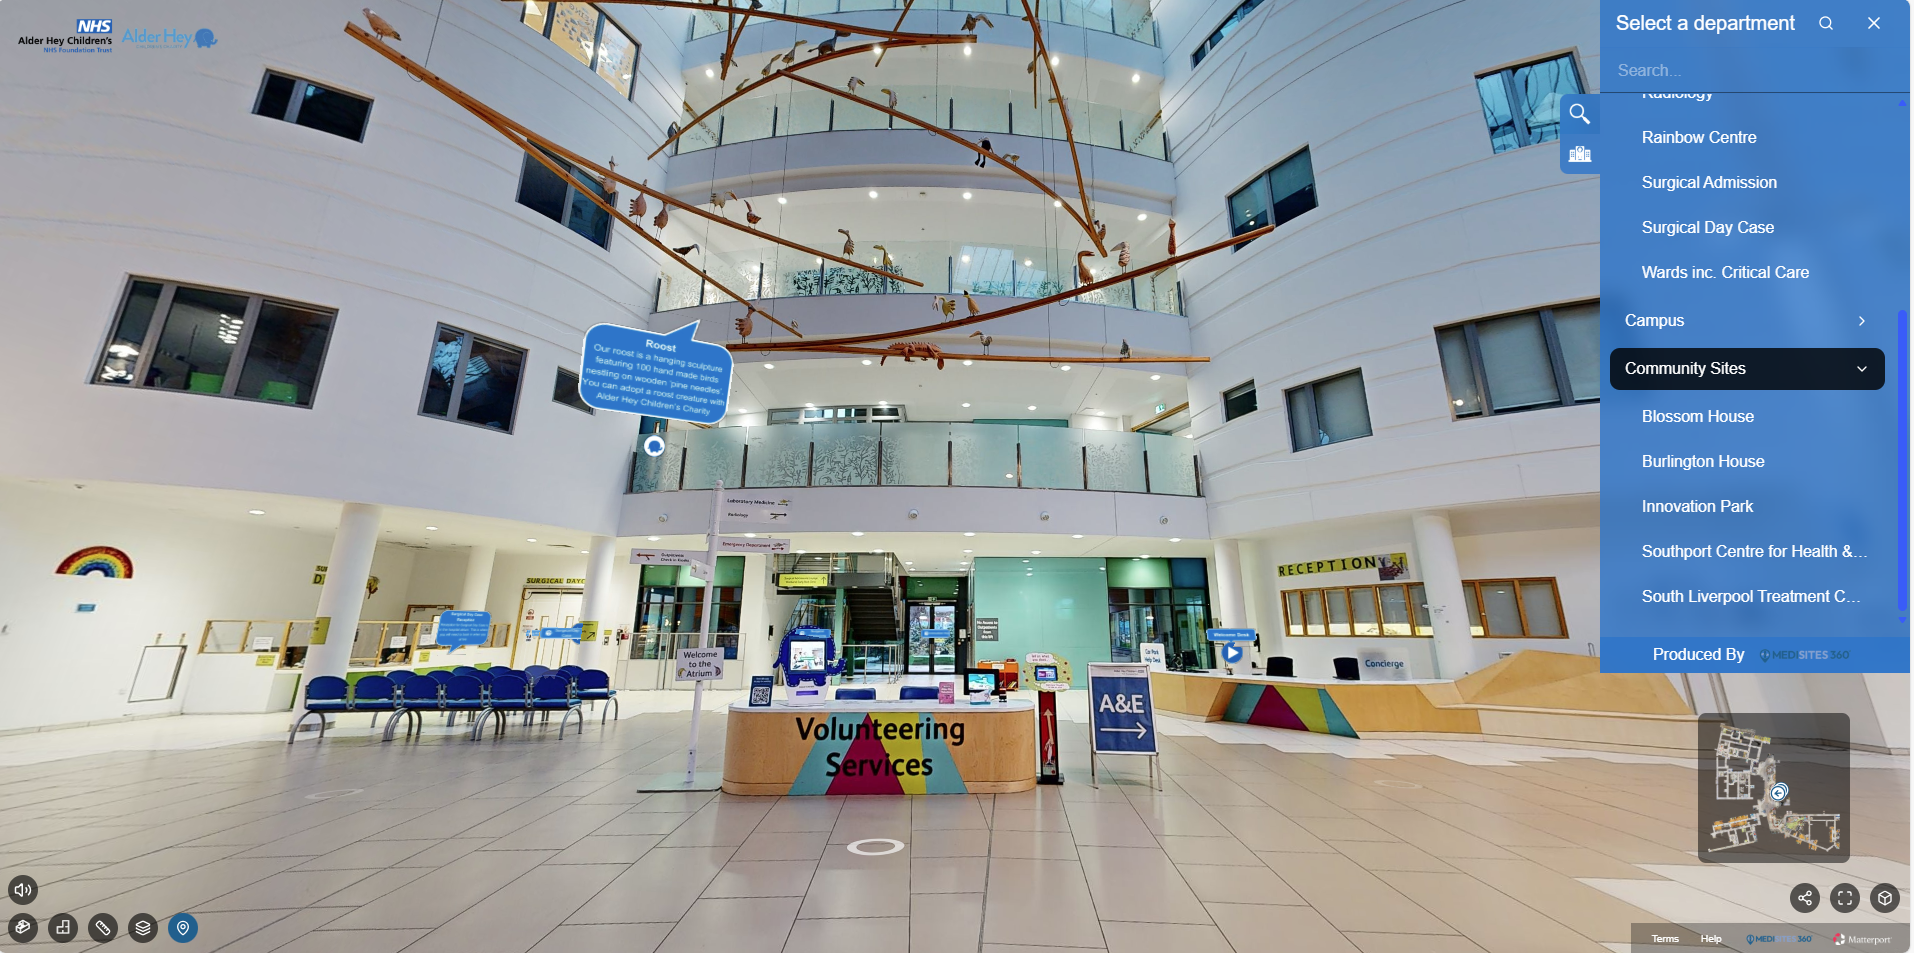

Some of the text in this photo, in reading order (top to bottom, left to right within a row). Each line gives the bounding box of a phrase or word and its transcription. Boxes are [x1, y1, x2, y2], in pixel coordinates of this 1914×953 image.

[1278, 556, 1377, 577] RECEPTION
[1365, 659, 1404, 669] Concierge
[1099, 694, 1145, 714] A&E
[796, 716, 965, 746] Volunteering
[826, 752, 933, 777] Services
